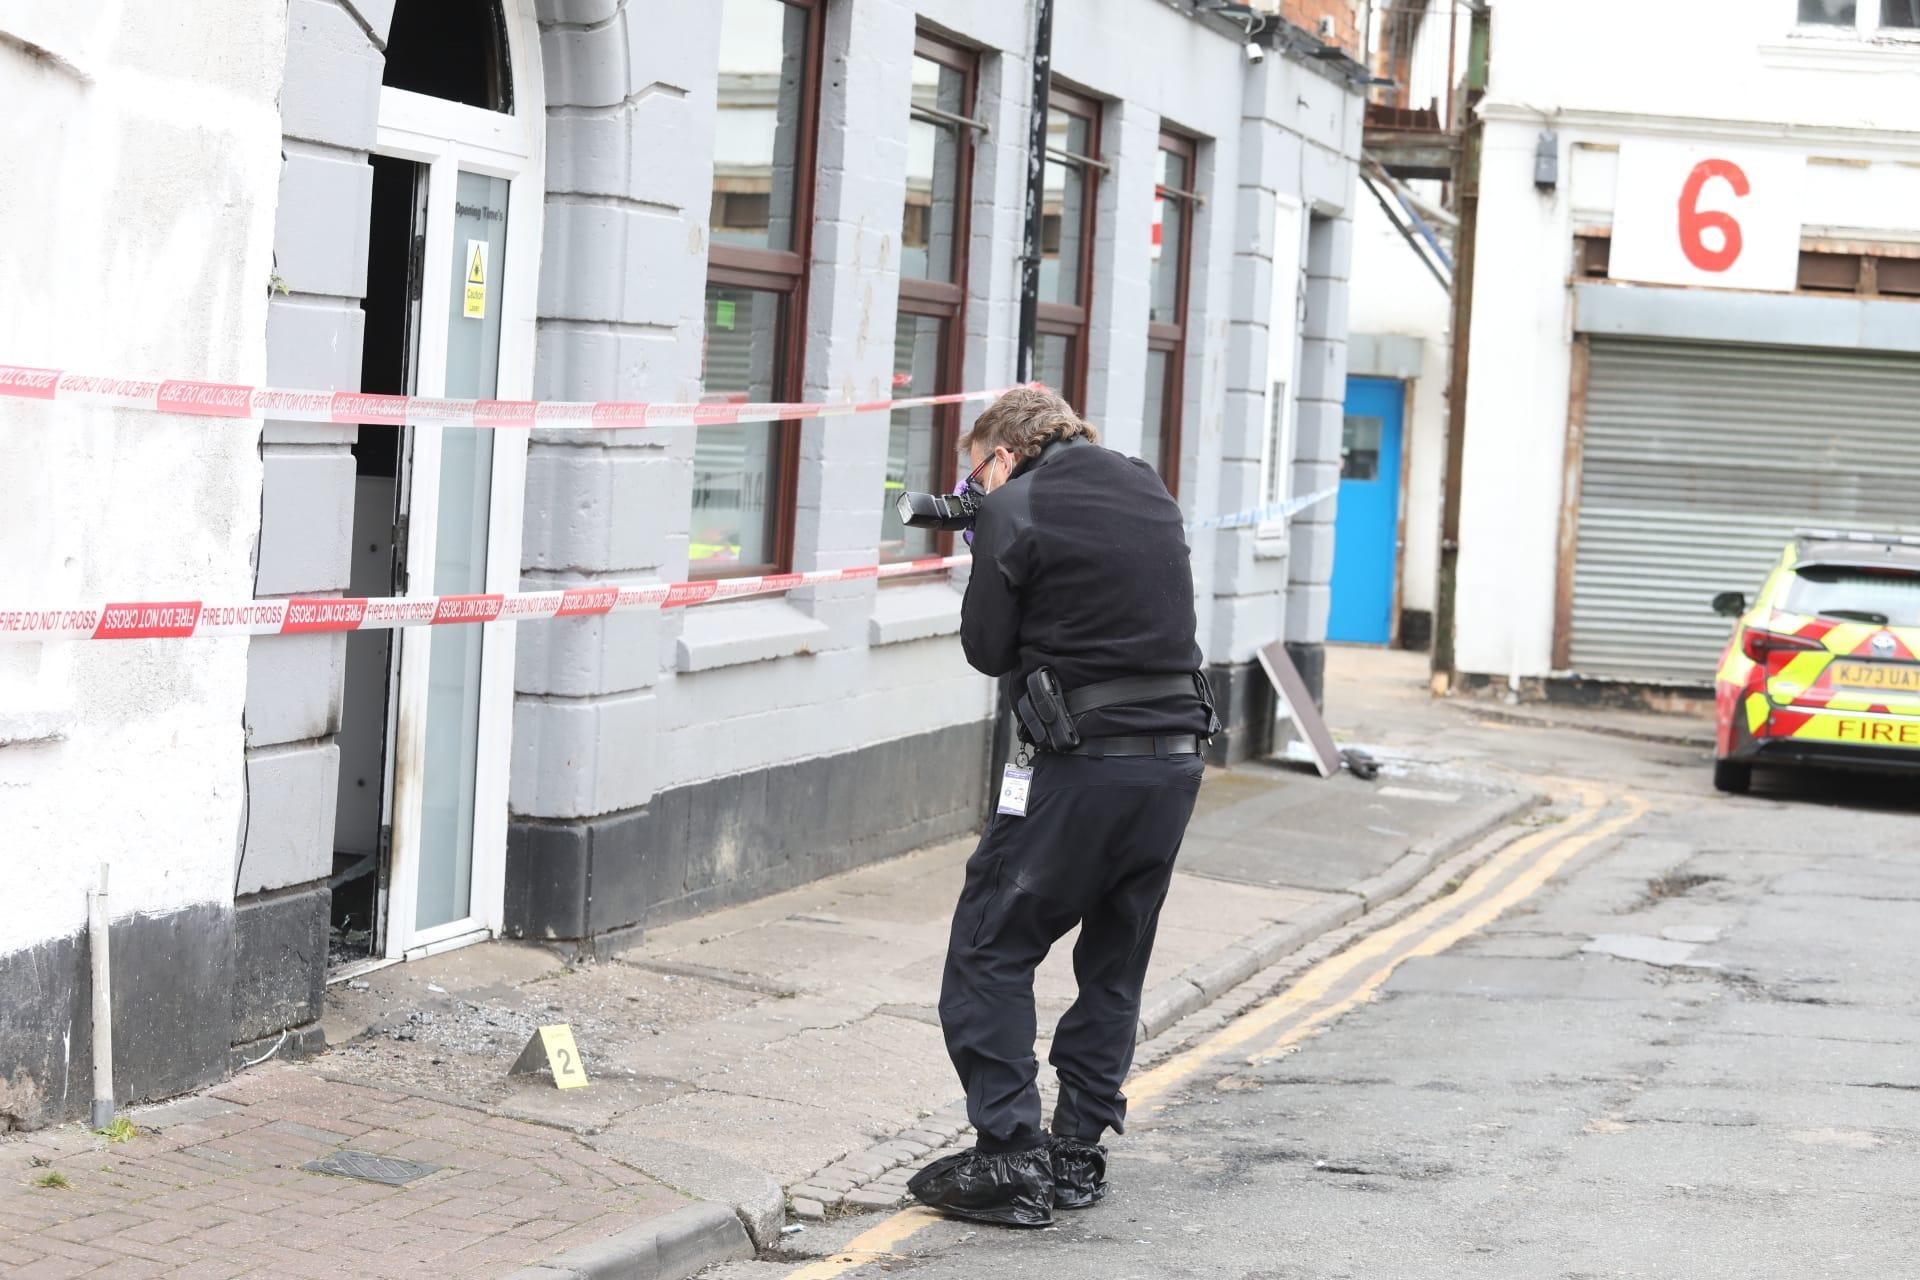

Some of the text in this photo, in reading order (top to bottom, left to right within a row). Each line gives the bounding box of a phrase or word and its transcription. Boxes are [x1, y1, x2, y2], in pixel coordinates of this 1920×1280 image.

[456, 201, 481, 221] Opening
[1678, 158, 1750, 272] 6
[0, 610, 96, 631] FIRE DO NOT CROSS
[105, 607, 195, 629] FIRE DO NOT CROSS
[201, 606, 283, 626] FIRE DO NOT CROSS
[289, 603, 362, 623] FIRE DO NOT CROSS
[410, 602, 434, 618] CROSS
[1840, 665, 1920, 686] KJ73 UAT
[1838, 720, 1919, 744] FIRE
[557, 1048, 575, 1075] 2
